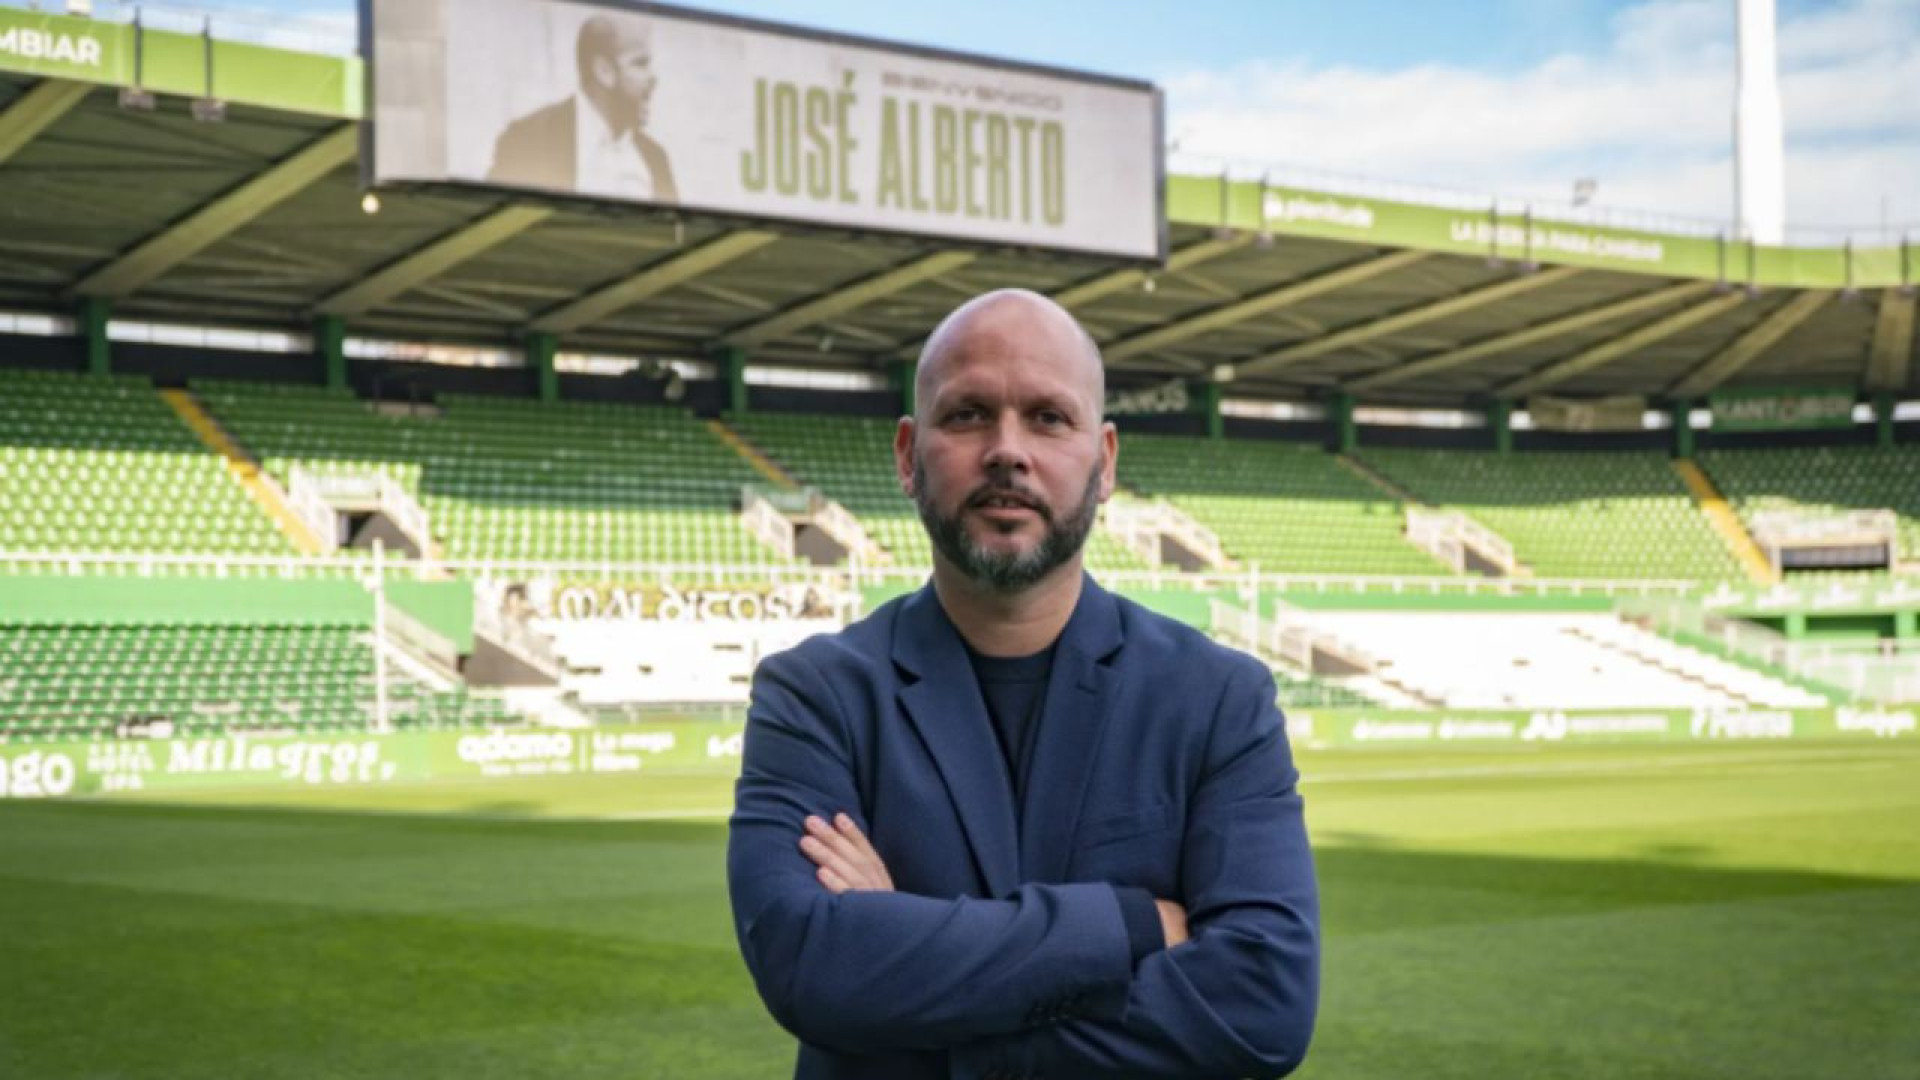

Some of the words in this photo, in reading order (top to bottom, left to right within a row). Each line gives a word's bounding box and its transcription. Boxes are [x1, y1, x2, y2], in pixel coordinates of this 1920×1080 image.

[740, 69, 859, 203] JOSÉ
[876, 96, 1066, 227] ALBERTO
[558, 585, 789, 620] MALDITOS
[169, 738, 379, 778] Milagros
